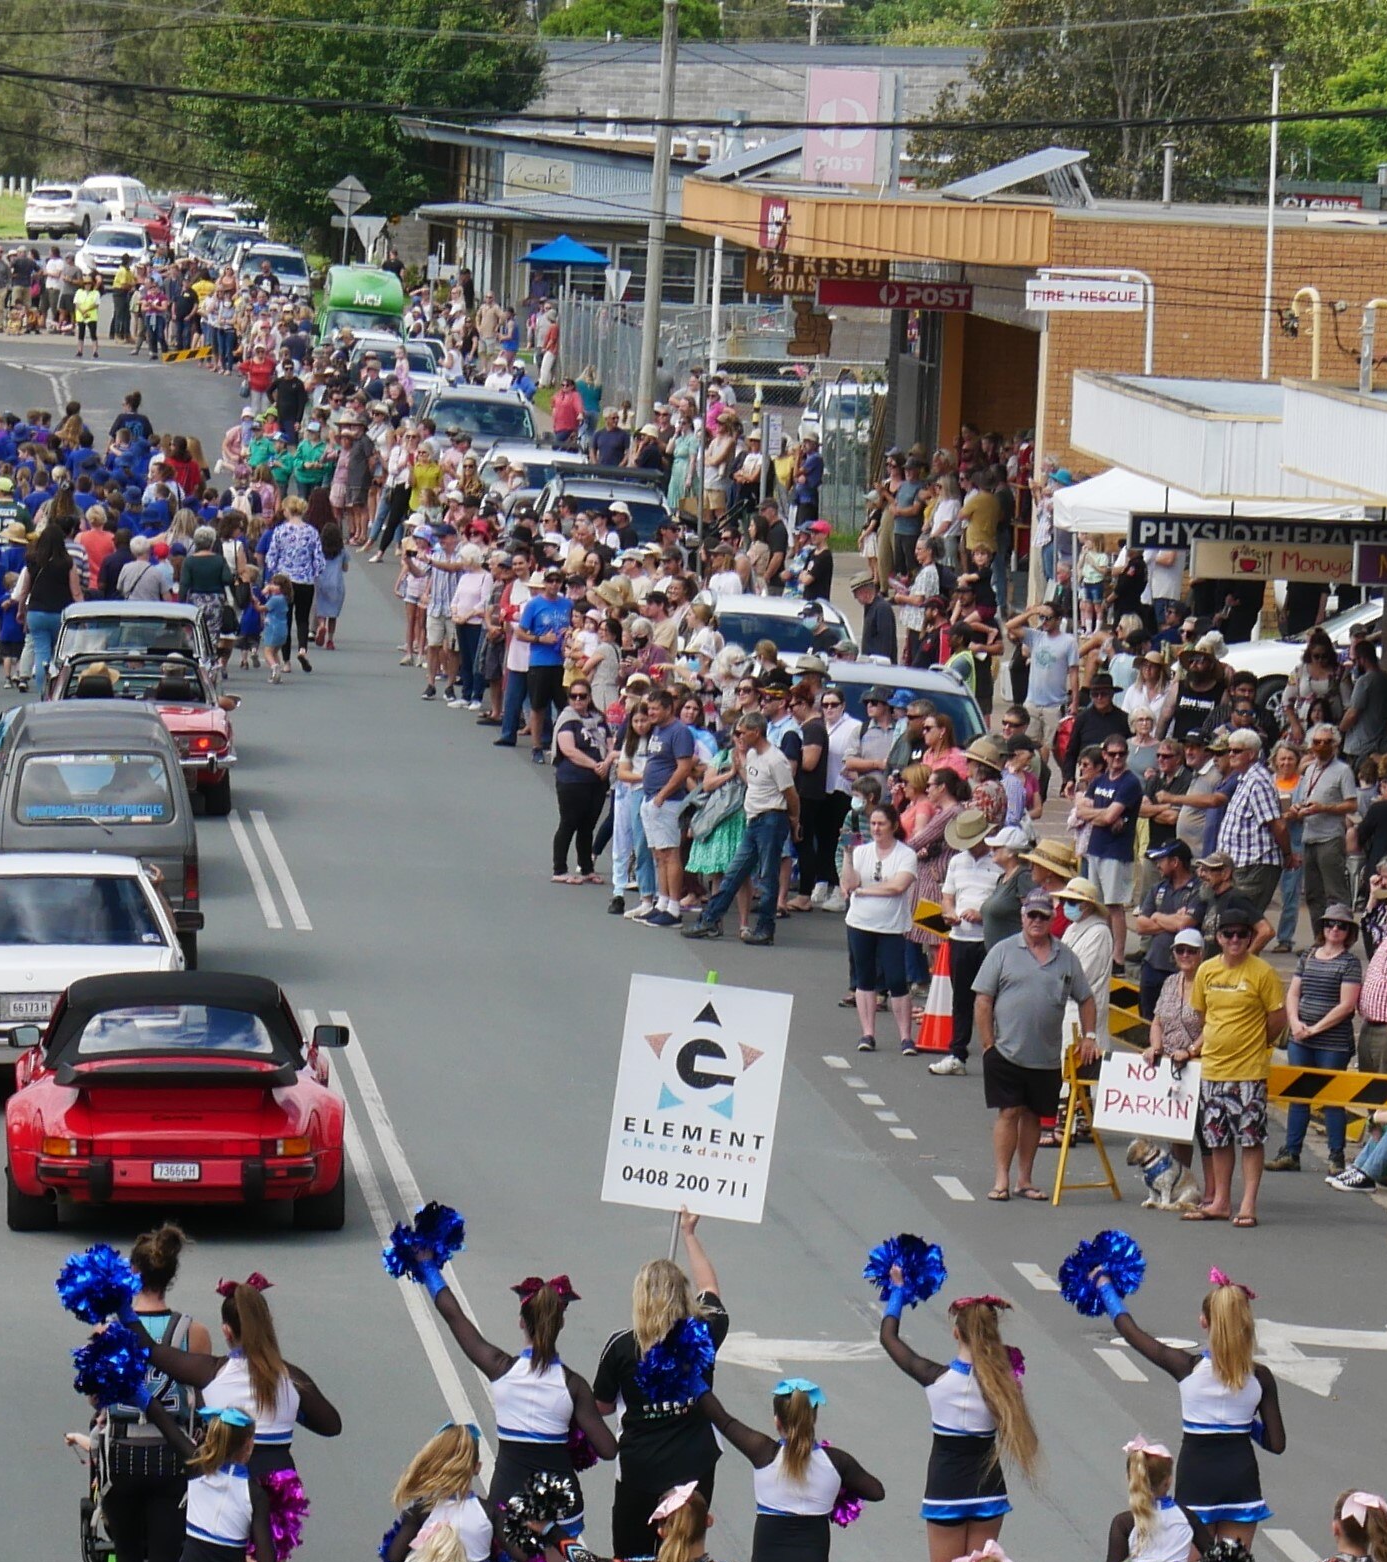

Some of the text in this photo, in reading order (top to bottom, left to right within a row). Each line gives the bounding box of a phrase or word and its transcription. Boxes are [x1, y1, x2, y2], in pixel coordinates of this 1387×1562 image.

[814, 155, 865, 170] POST
[523, 164, 566, 186] café
[756, 253, 881, 276] ALFRESCO
[905, 287, 970, 307] POST
[1032, 290, 1065, 302] FIRE
[1079, 290, 1137, 303] RESCUE
[1127, 1063, 1157, 1082] NO
[623, 1116, 766, 1150] ELEMENT
[622, 1165, 749, 1198] 0408 200 711
